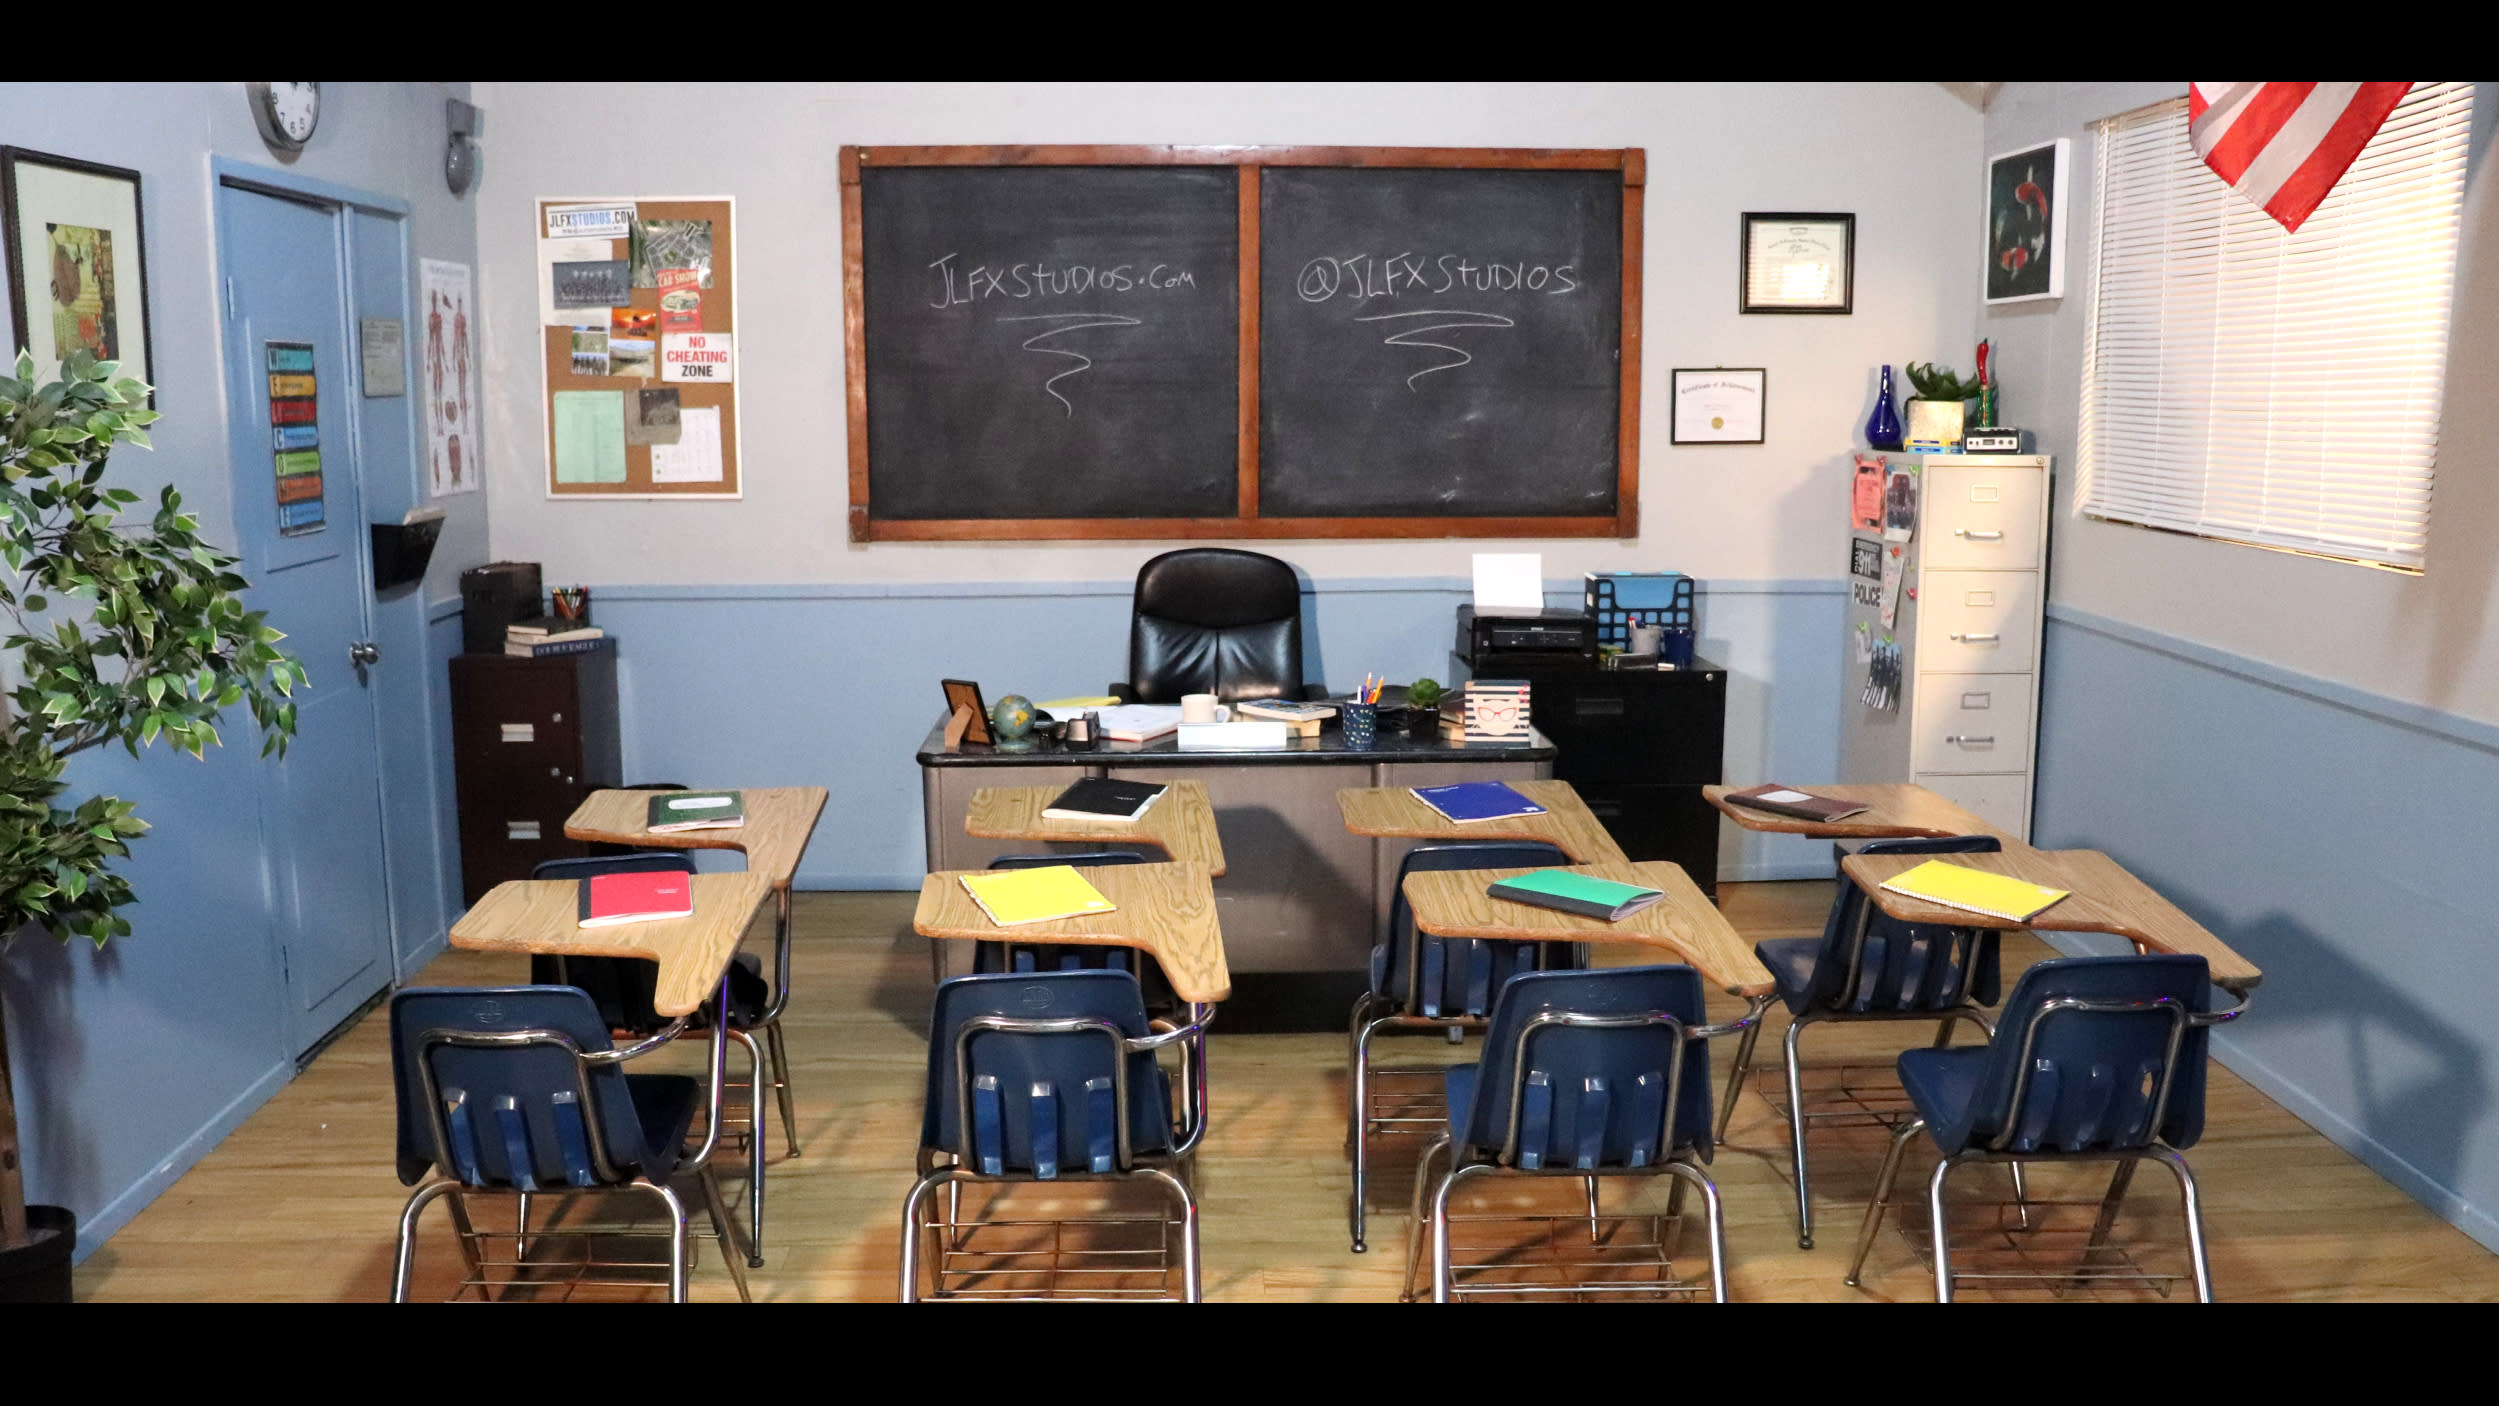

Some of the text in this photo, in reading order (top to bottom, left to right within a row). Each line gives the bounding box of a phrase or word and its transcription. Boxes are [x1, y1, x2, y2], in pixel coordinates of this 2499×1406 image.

[272, 92, 279, 105] 8
[549, 210, 635, 228] JLFXSTUDIOS.COM
[688, 336, 706, 349] NO
[666, 350, 728, 363] CHEATING
[681, 364, 713, 377] ZONE
[1858, 551, 1871, 577] 911
[1854, 583, 1881, 608] POLICE
